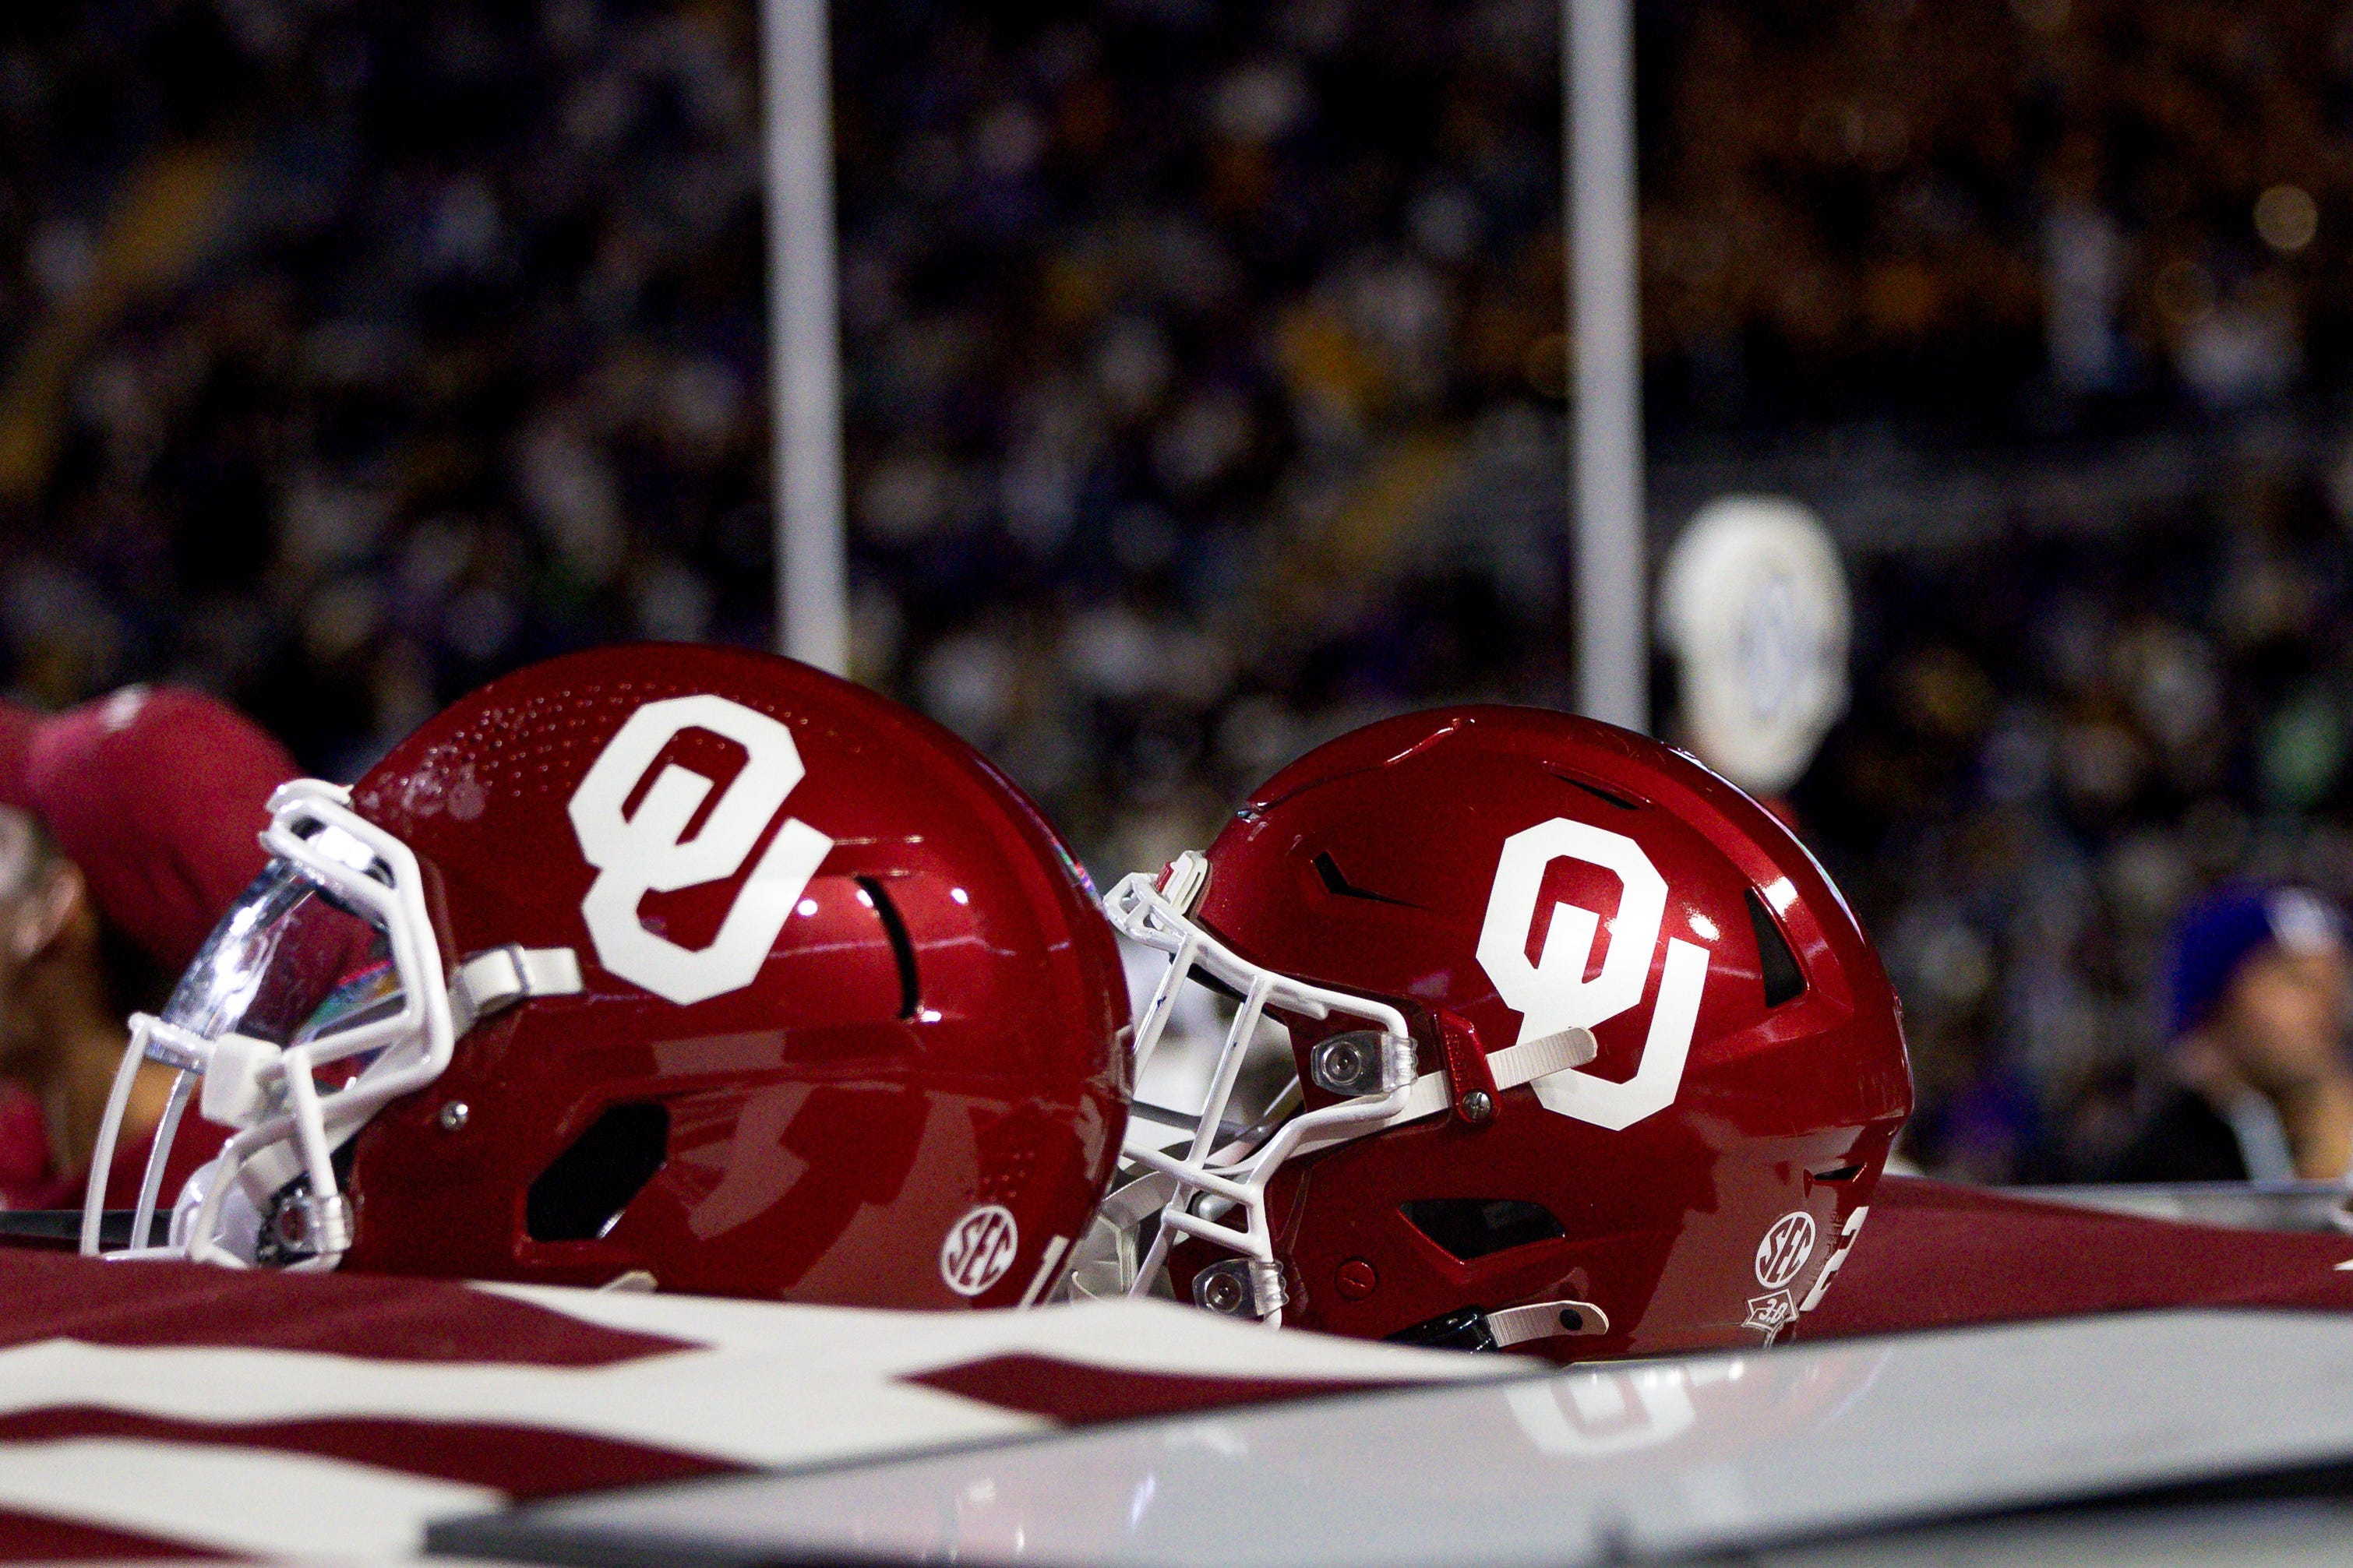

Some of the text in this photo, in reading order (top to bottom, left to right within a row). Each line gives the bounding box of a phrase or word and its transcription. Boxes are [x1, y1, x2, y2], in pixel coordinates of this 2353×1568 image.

[566, 694, 834, 1006] OU
[1476, 817, 1710, 1131] OU
[944, 1209, 1015, 1291] SEC
[1758, 1215, 1814, 1286] SEC
